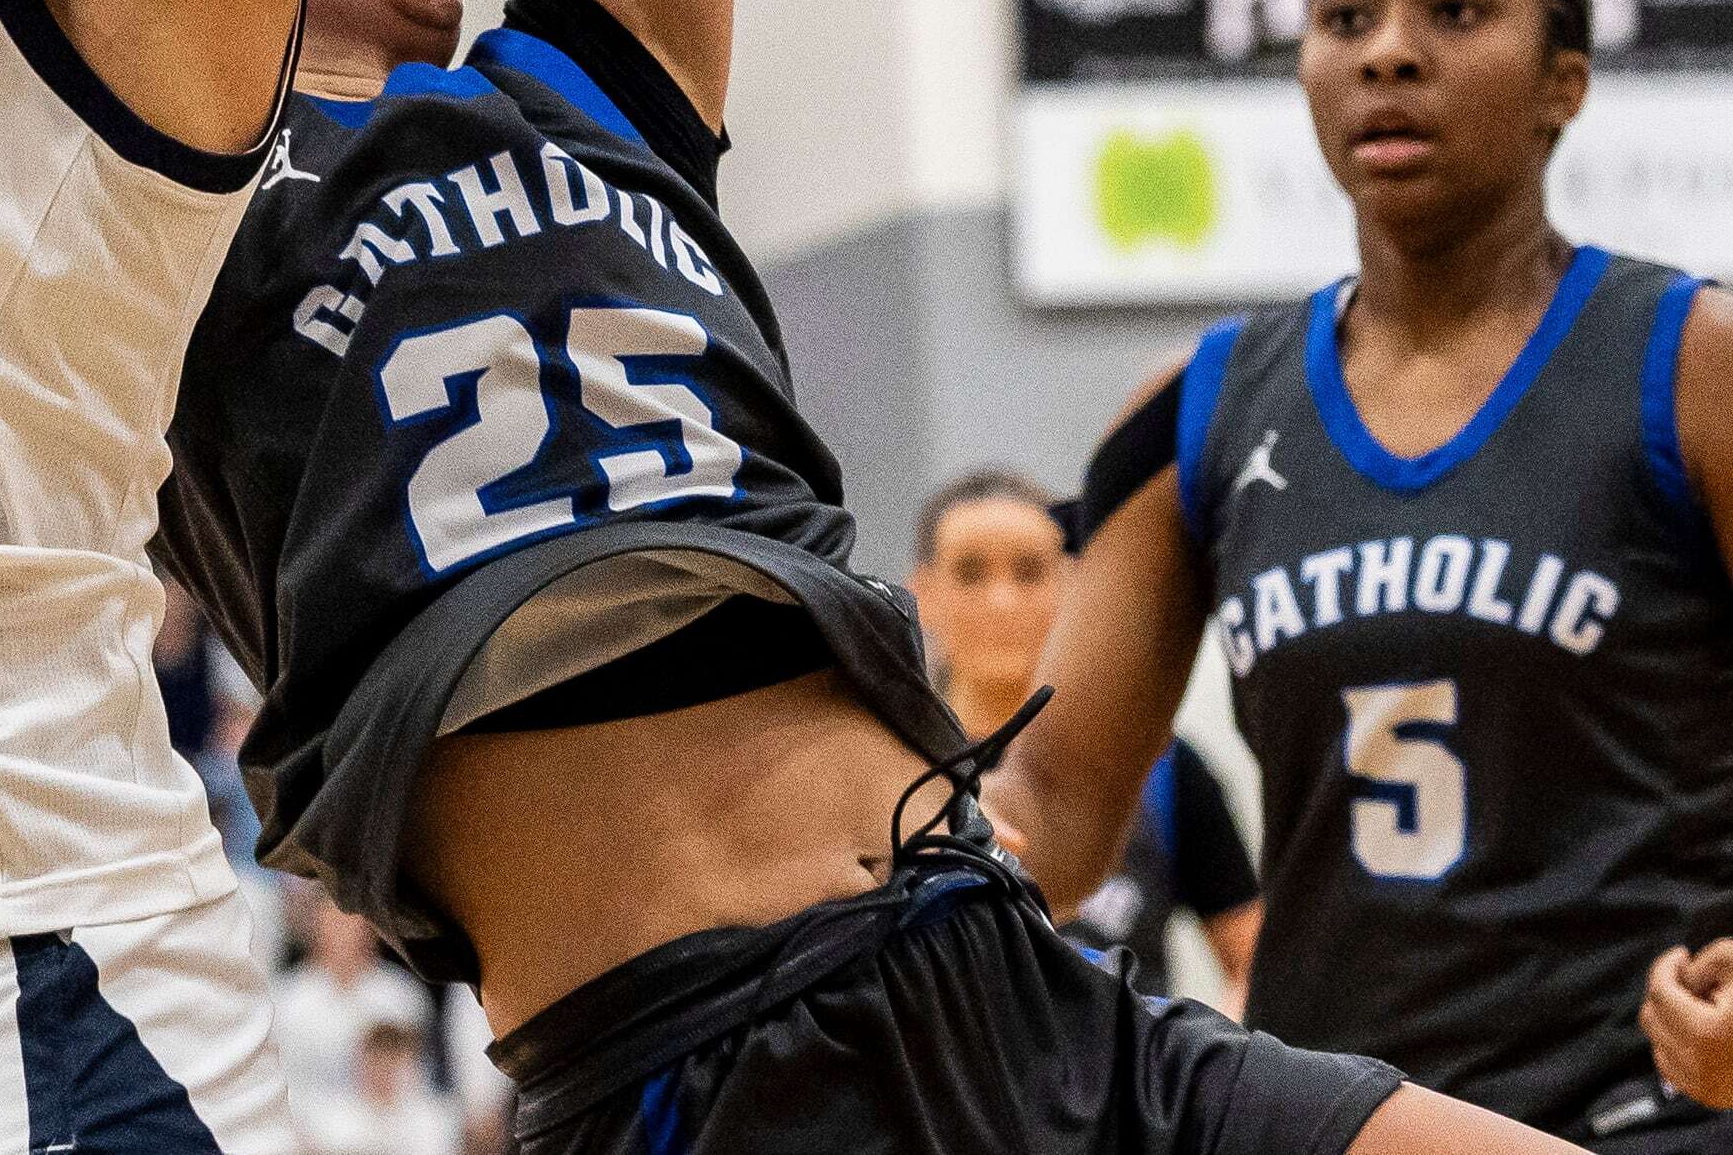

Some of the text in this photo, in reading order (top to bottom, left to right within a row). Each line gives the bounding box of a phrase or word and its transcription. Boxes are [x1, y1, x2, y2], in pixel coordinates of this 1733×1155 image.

[380, 307, 743, 573] 25
[1219, 534, 1621, 677] CATHOLIC
[1341, 679, 1469, 880] 5
